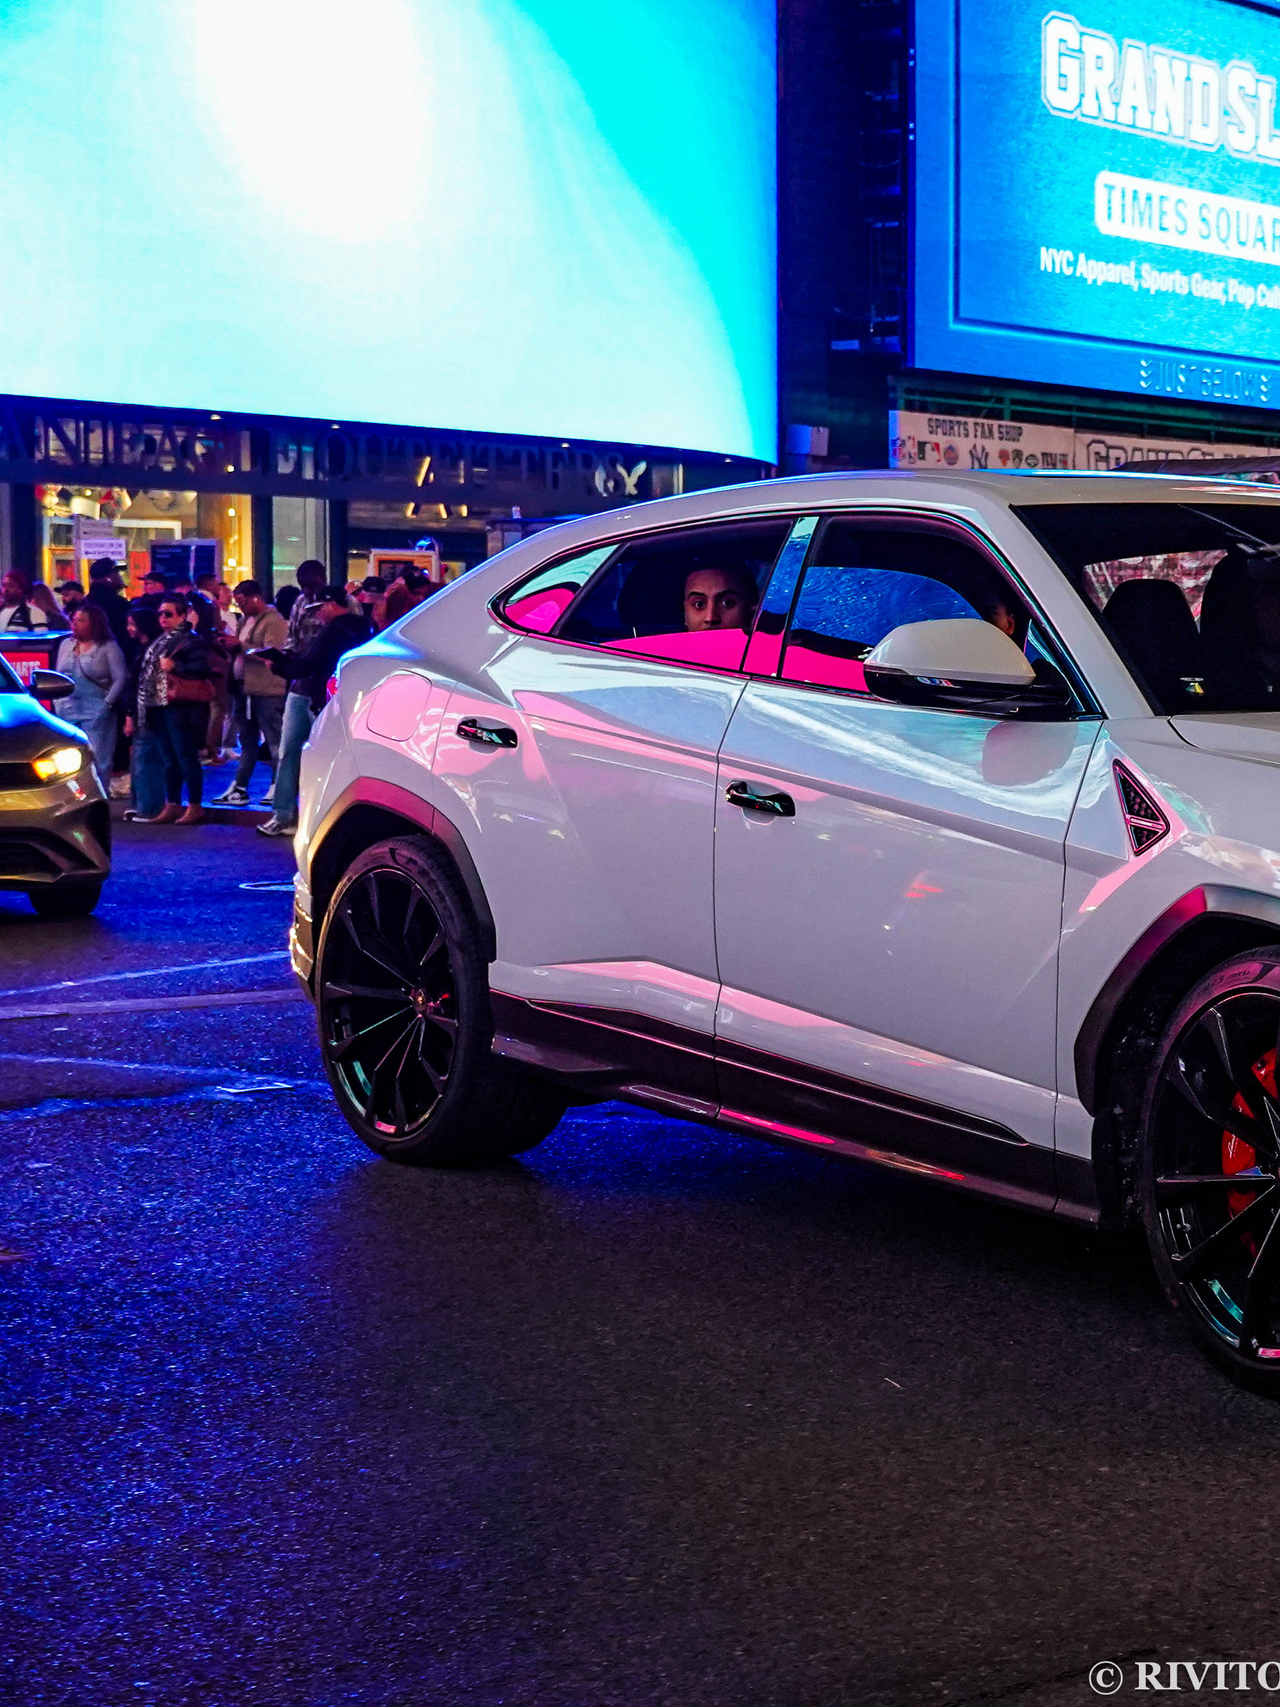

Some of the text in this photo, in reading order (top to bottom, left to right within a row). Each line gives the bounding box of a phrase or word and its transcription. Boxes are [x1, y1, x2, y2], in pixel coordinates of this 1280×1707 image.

[1103, 183, 1188, 235] TIMES
[1040, 246, 1074, 275] NYC
[1076, 253, 1139, 291] Apparel,
[1140, 262, 1189, 295] Sports
[1191, 271, 1227, 305] Gear,
[1228, 278, 1256, 308] Pop
[927, 418, 1023, 443] SPORTS FAN SHOP
